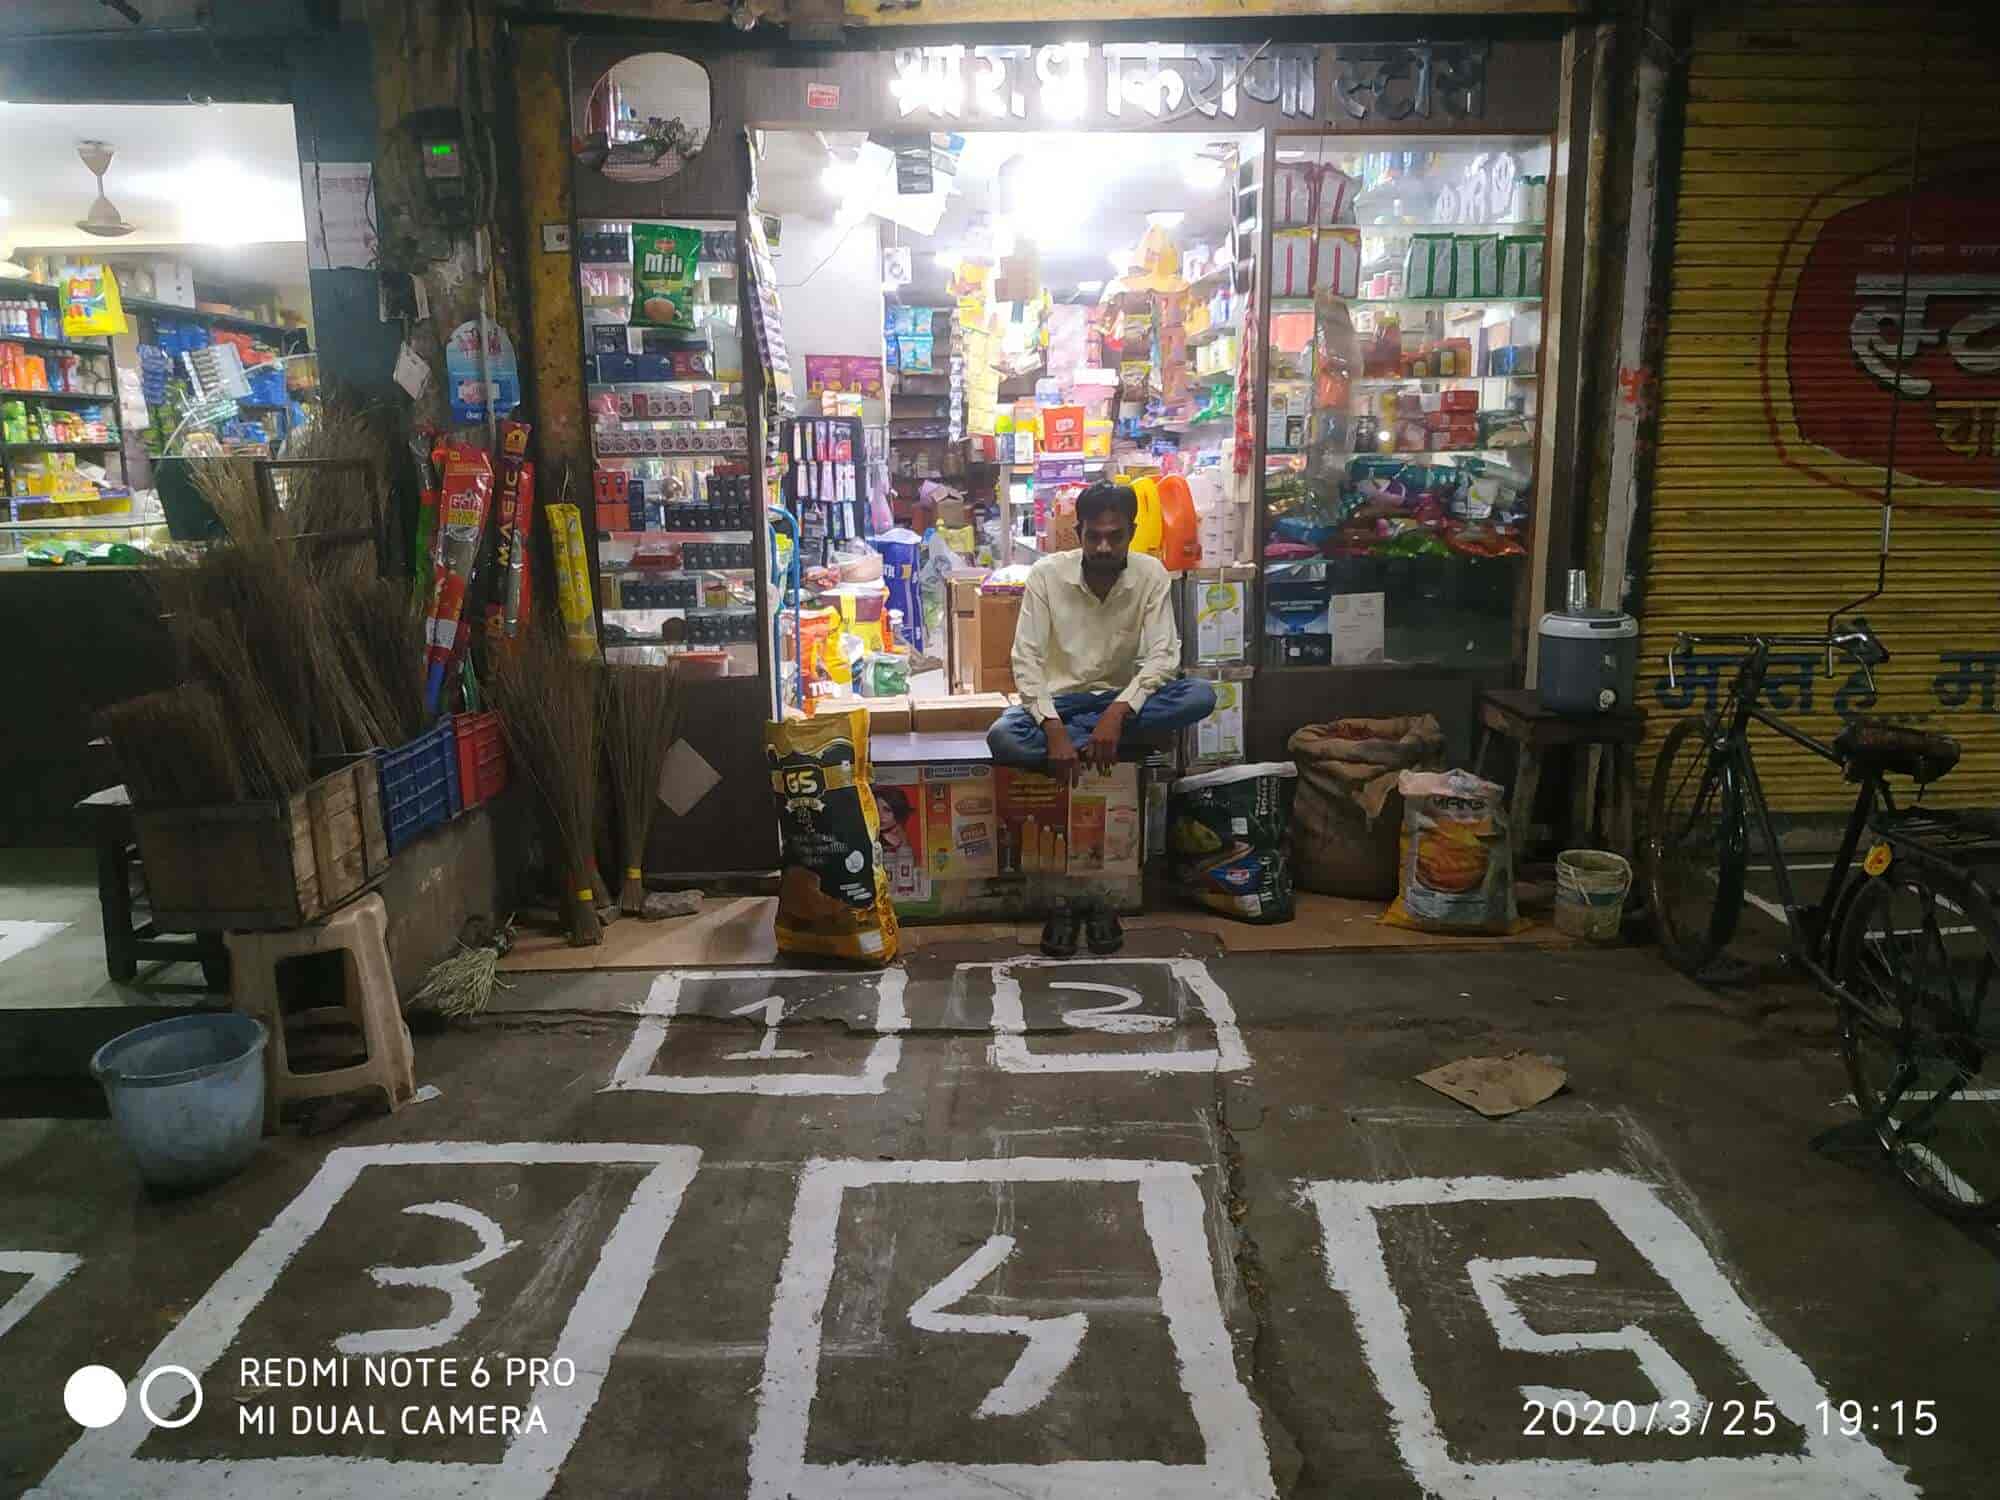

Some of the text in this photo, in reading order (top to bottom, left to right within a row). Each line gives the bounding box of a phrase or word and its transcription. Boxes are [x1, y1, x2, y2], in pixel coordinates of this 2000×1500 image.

[721, 981, 1178, 1061] 1 2
[330, 1199, 524, 1356] 3
[1467, 1254, 1706, 1432] 5
